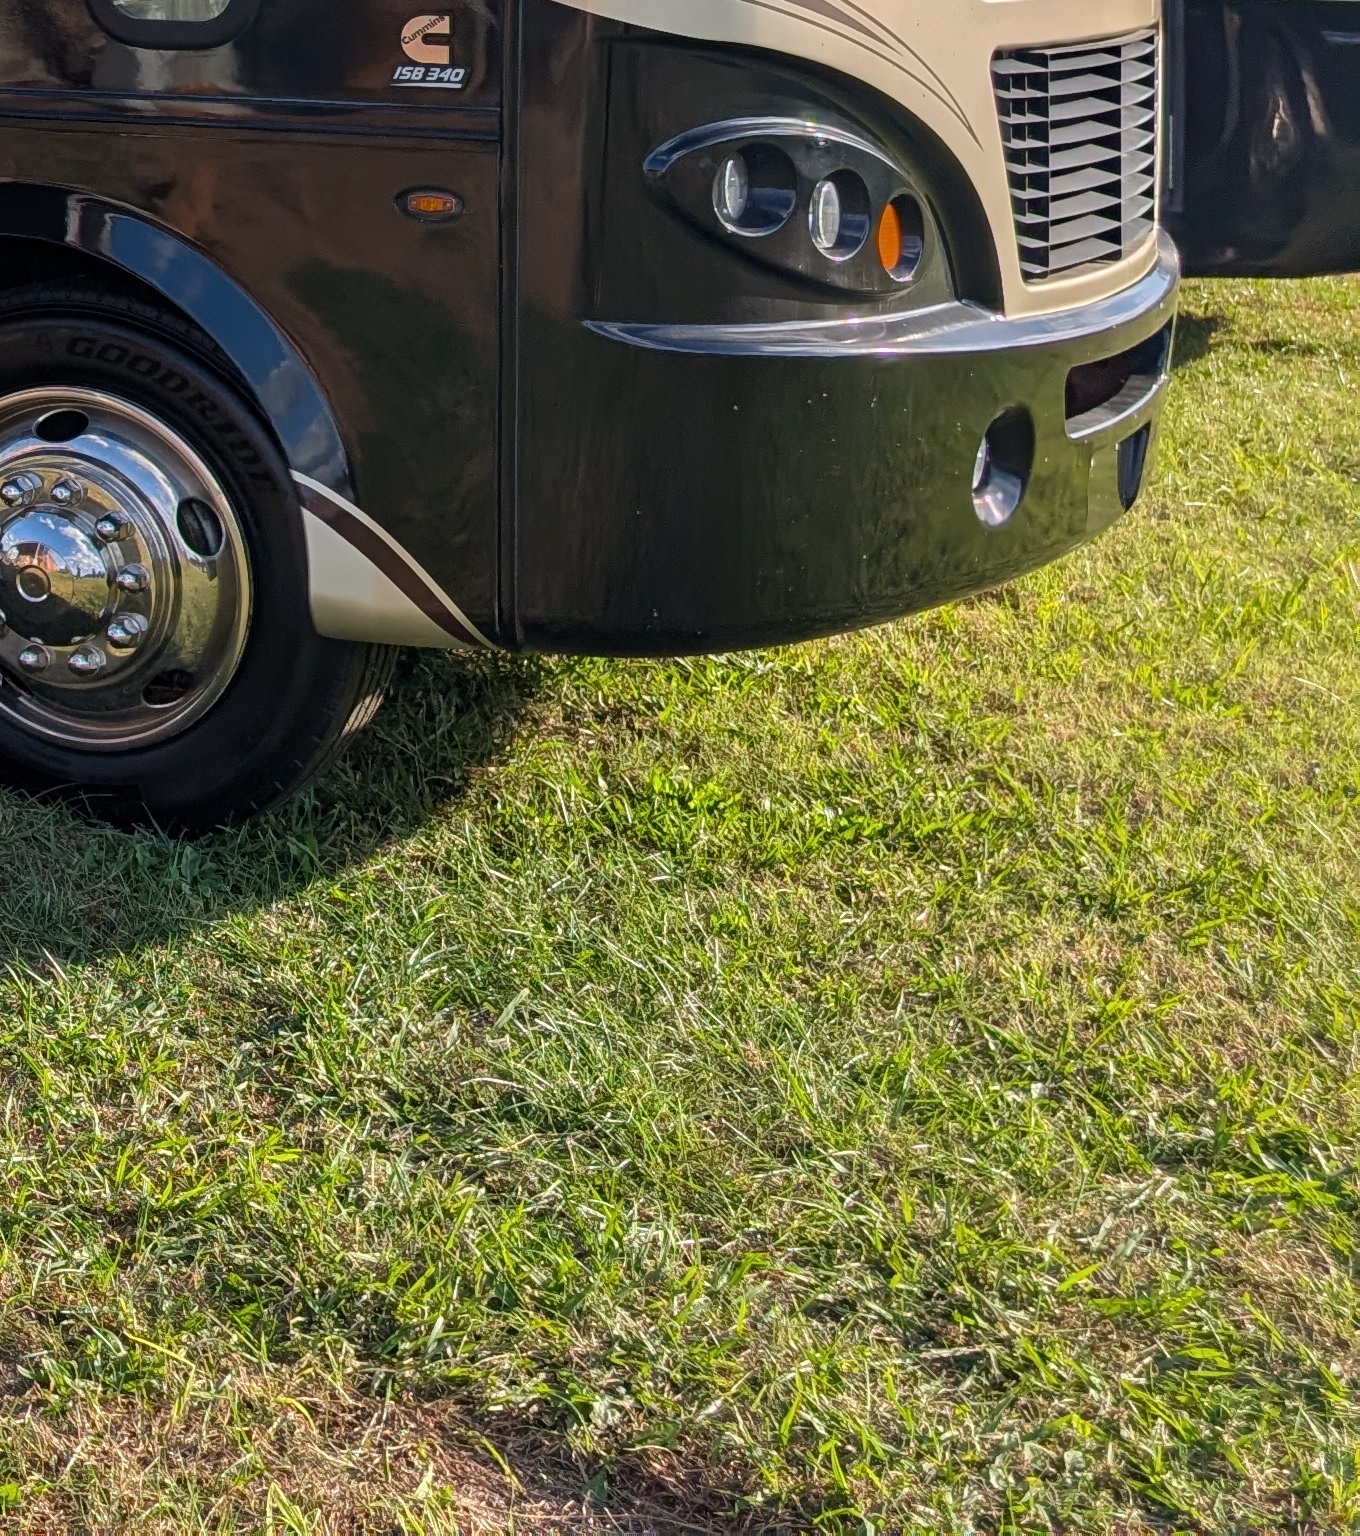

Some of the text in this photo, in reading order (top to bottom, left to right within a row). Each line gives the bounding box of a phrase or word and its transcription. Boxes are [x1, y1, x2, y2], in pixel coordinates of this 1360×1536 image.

[401, 15, 446, 45] Cummins
[392, 66, 466, 82] ISB 340
